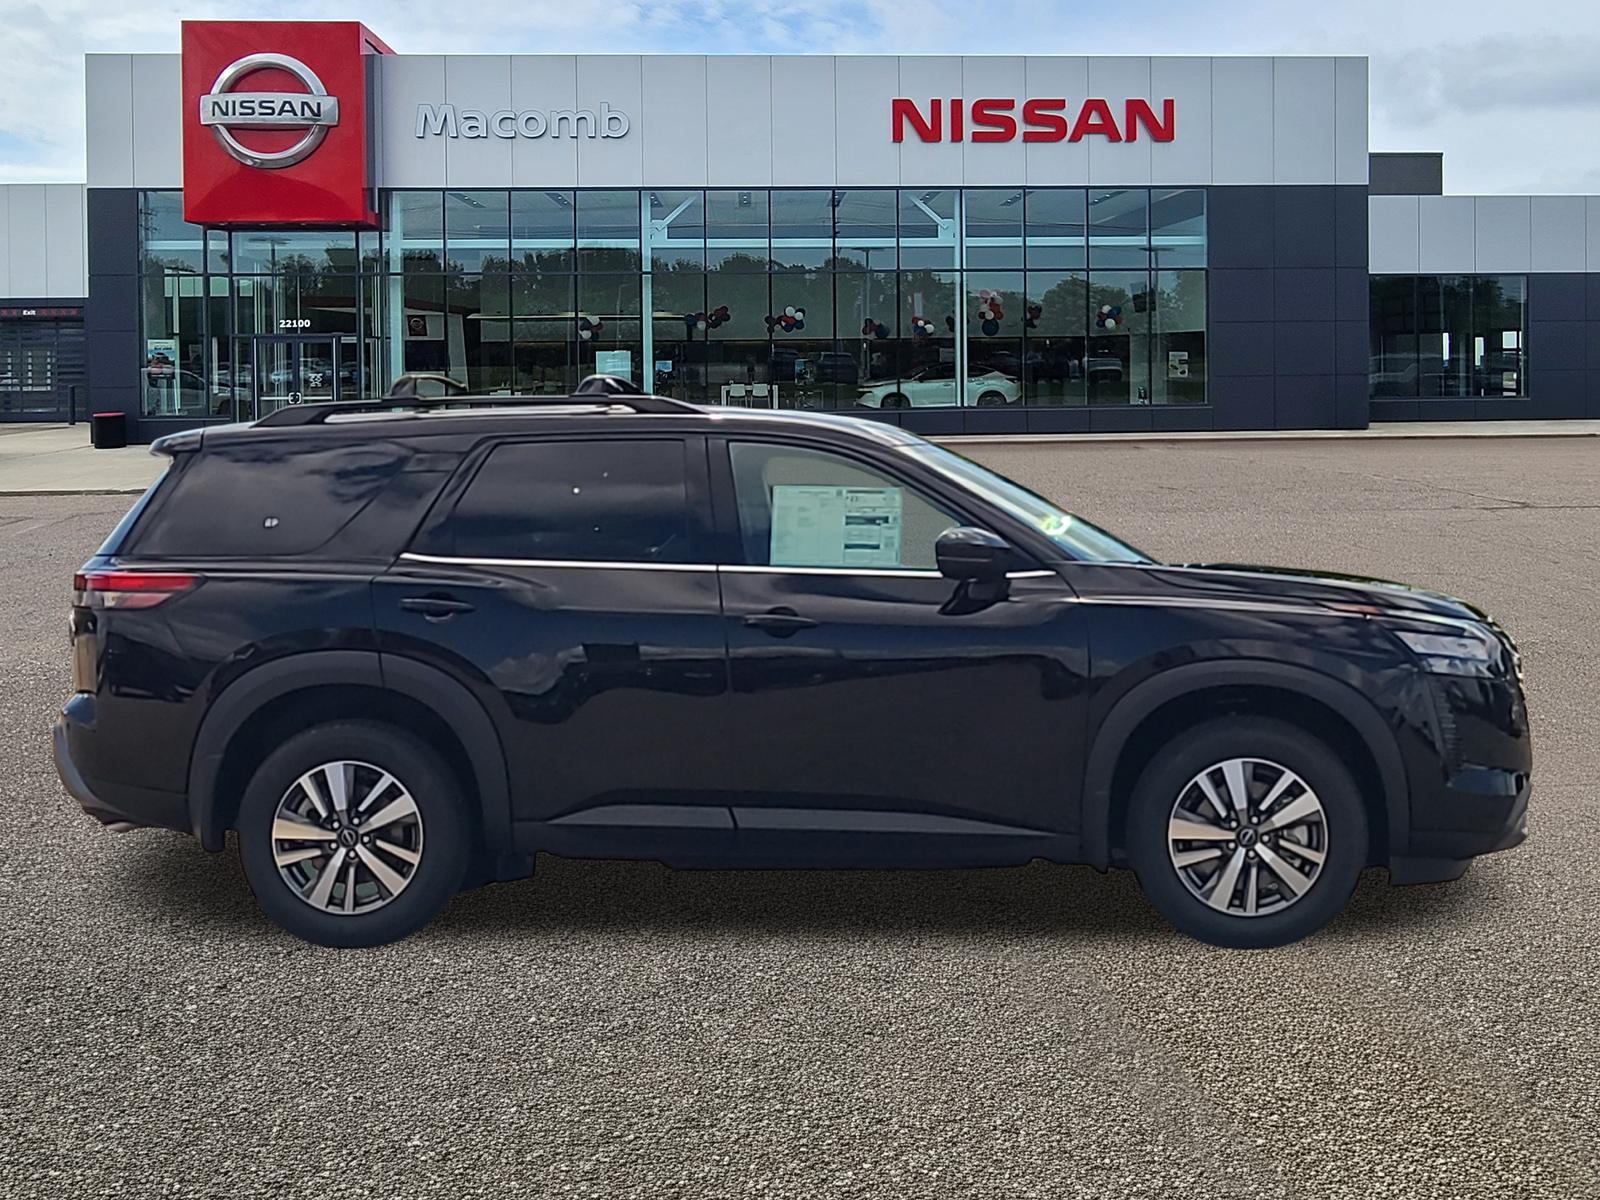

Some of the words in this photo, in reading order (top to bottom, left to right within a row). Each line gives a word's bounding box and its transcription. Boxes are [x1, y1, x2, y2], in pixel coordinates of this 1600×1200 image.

[212, 100, 321, 118] NISSAN
[415, 102, 630, 139] Macomb
[892, 98, 1175, 143] NISSAN
[279, 319, 311, 328] 22100
